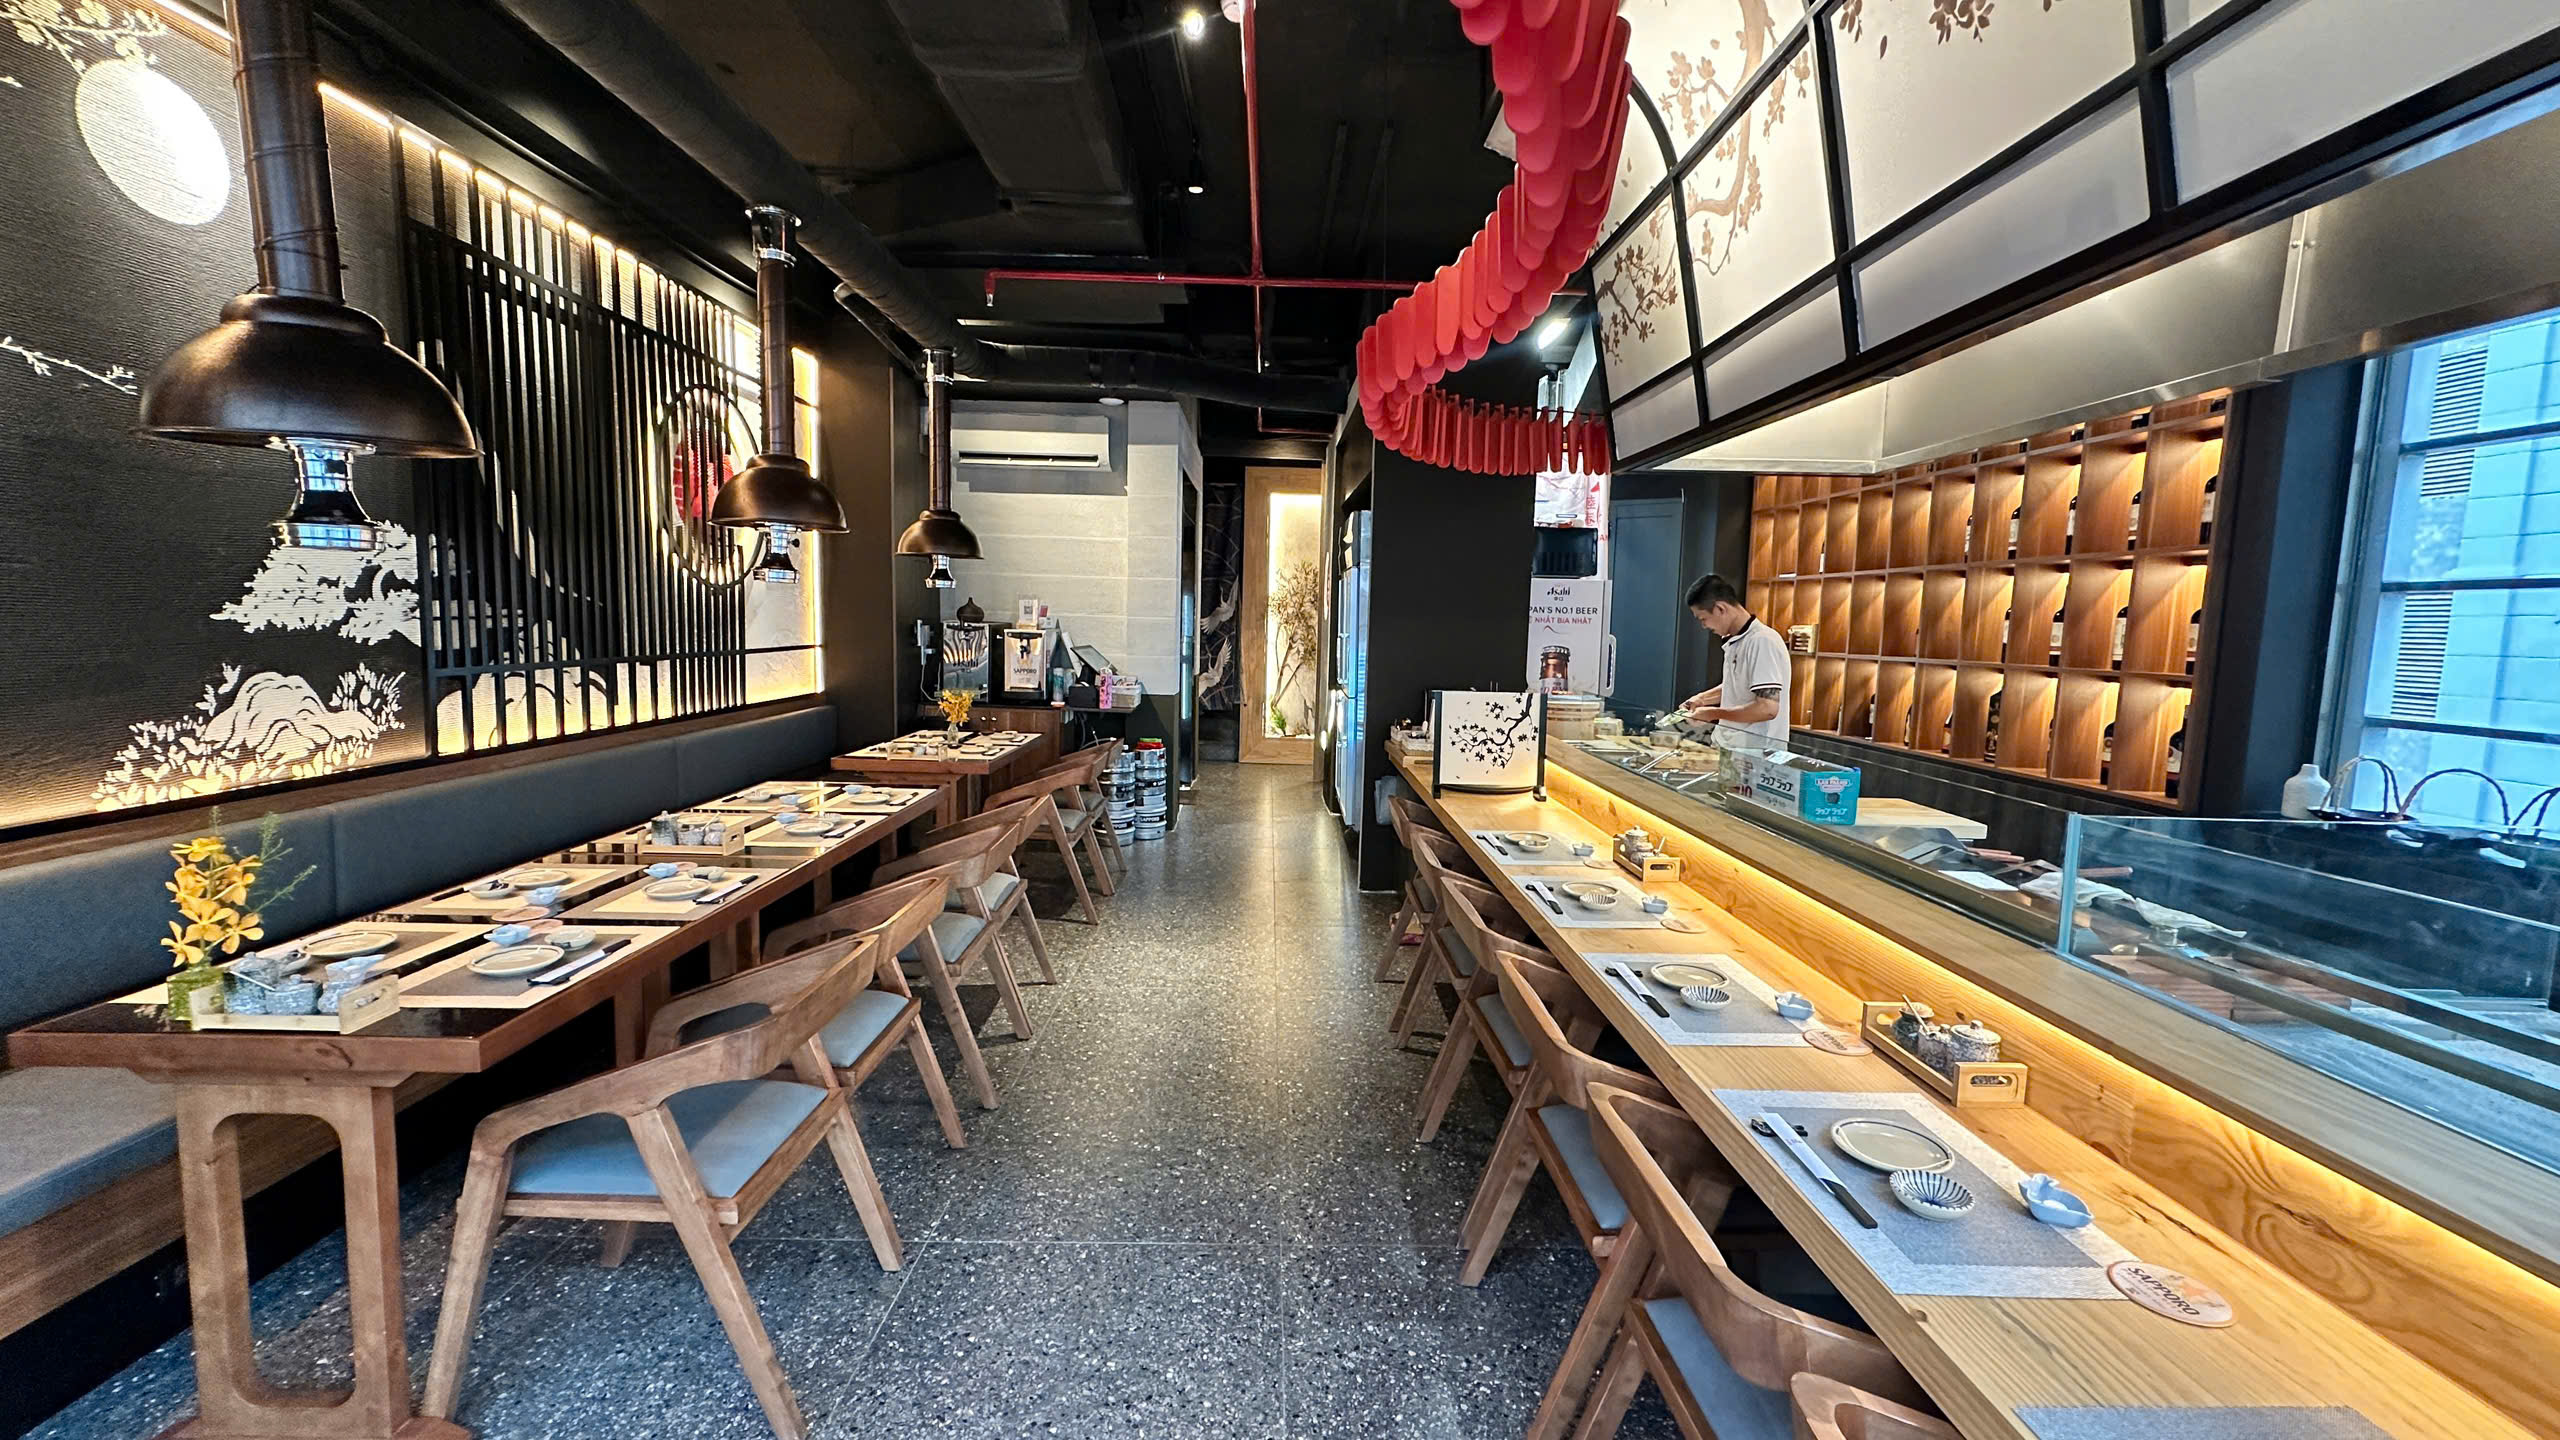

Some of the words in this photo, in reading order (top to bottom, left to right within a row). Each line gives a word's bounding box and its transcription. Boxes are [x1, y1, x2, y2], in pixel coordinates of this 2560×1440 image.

[1547, 587, 1571, 596] Asahi
[1555, 606, 1573, 615] NO.1
[1576, 607, 1598, 615] BEER
[2128, 1267, 2200, 1315] SAPPORO
